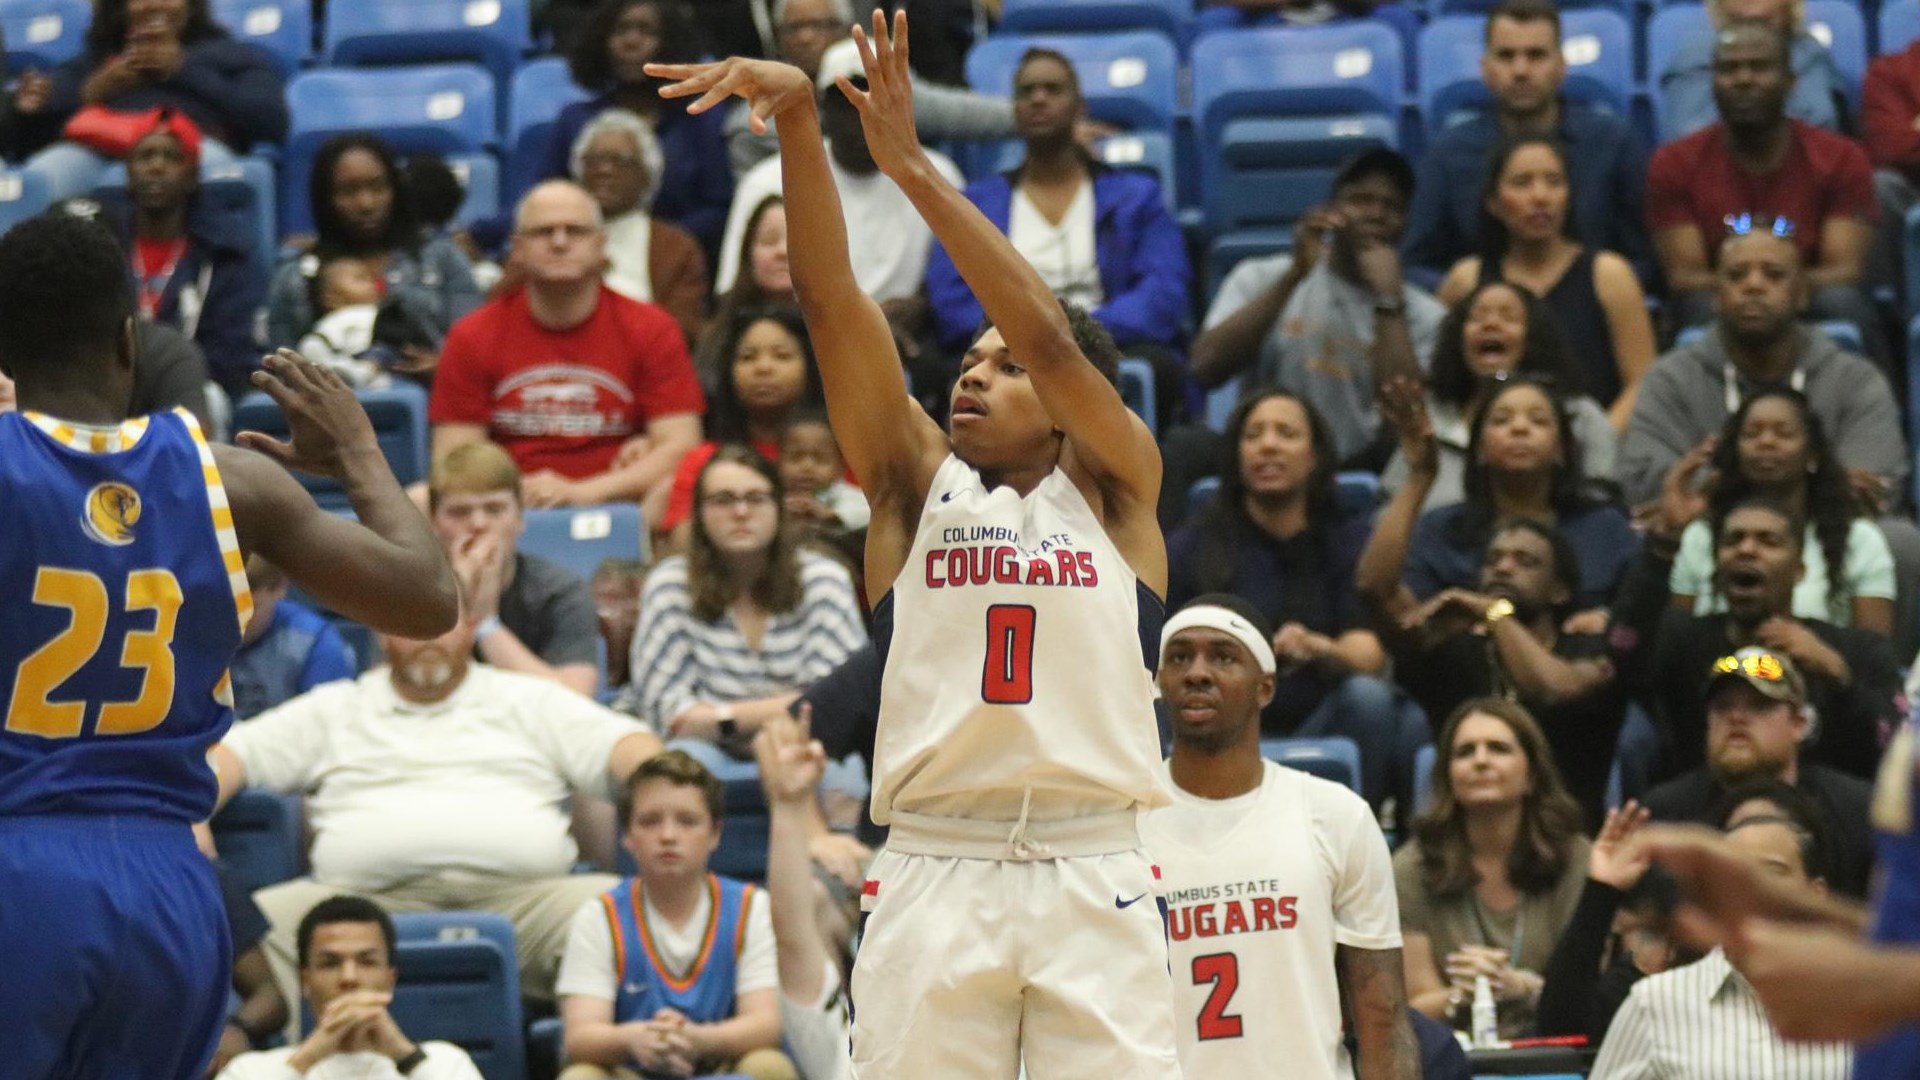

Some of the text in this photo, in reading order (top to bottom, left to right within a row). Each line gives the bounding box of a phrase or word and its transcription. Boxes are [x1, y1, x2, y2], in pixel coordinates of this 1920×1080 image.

[943, 525, 1021, 544] COLUMBU
[925, 545, 1099, 589] COUGARS
[4, 564, 185, 740] 23
[981, 603, 1037, 705] 0
[1165, 879, 1280, 905] UMBUS STATE
[1167, 896, 1298, 942] UGARS
[1191, 951, 1244, 1042] 2
